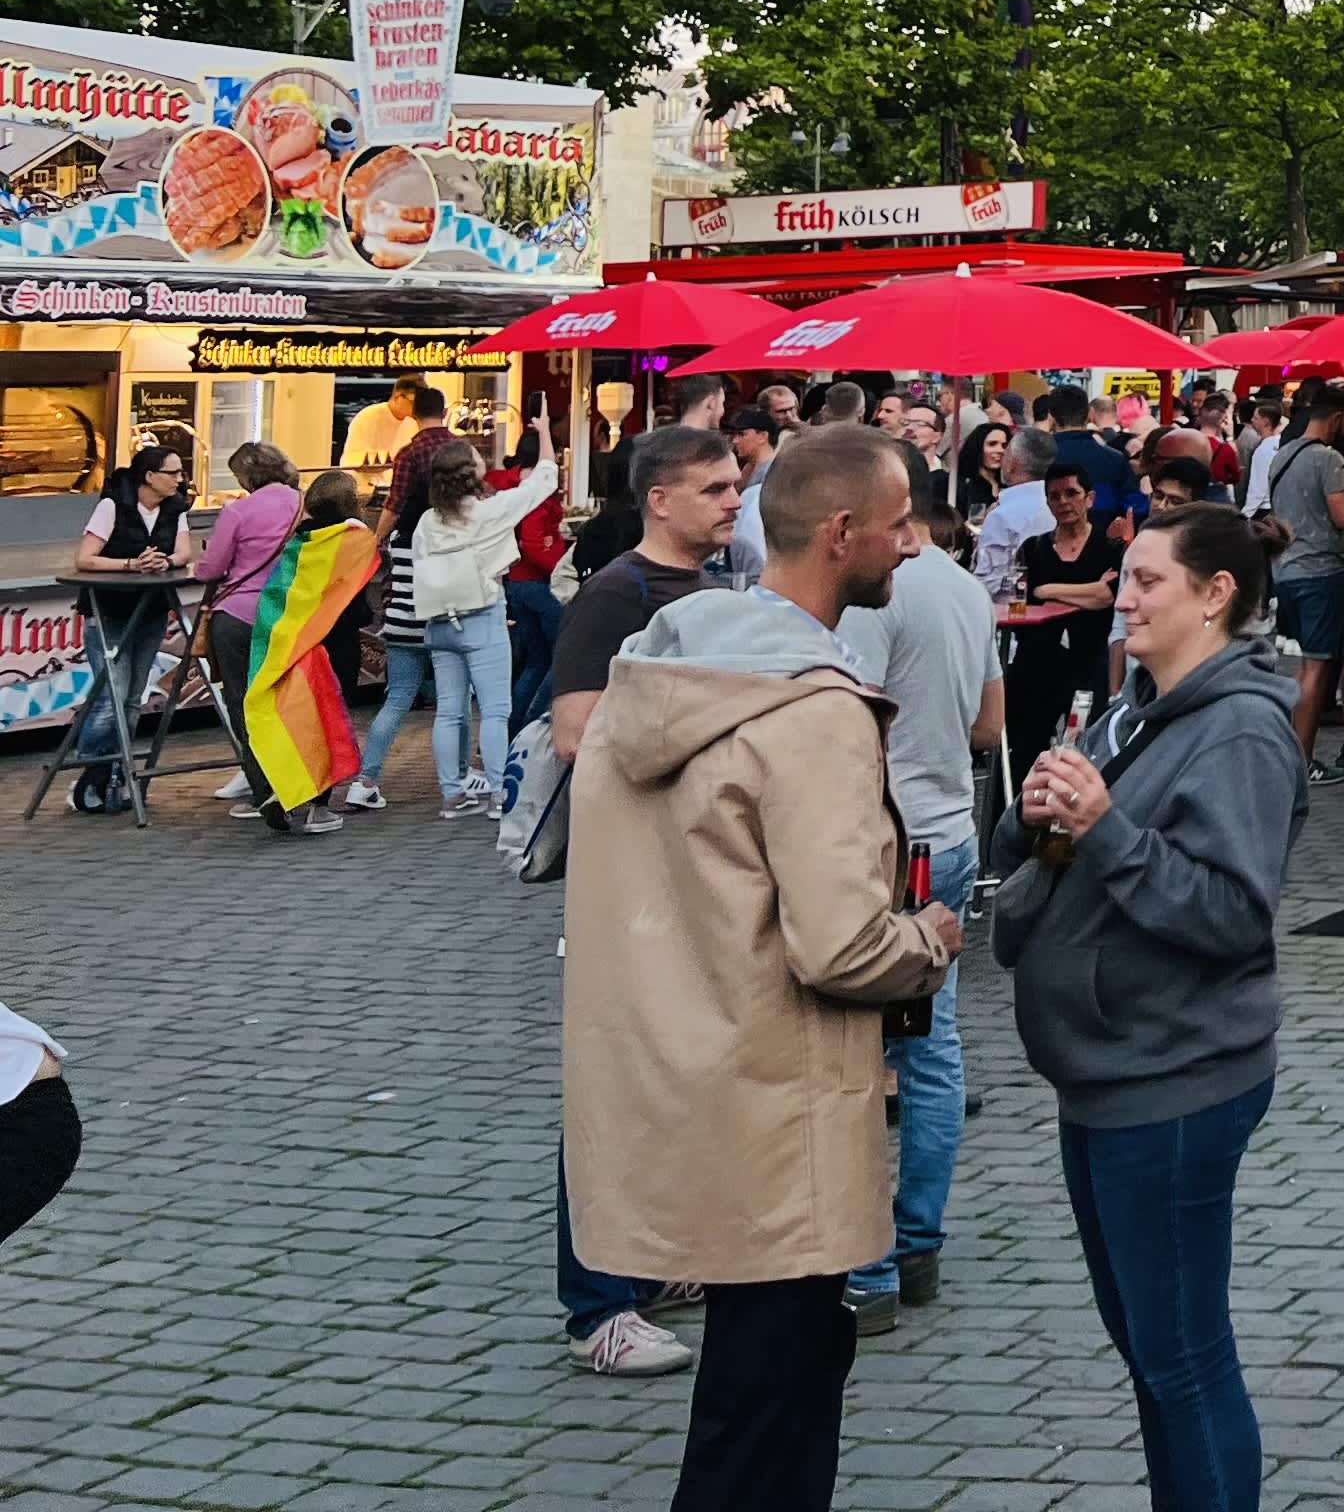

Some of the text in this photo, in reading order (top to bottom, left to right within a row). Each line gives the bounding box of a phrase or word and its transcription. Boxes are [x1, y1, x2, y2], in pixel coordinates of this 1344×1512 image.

[774, 199, 919, 232] früh KÖLSCH
[147, 282, 305, 318] Krustenbraten
